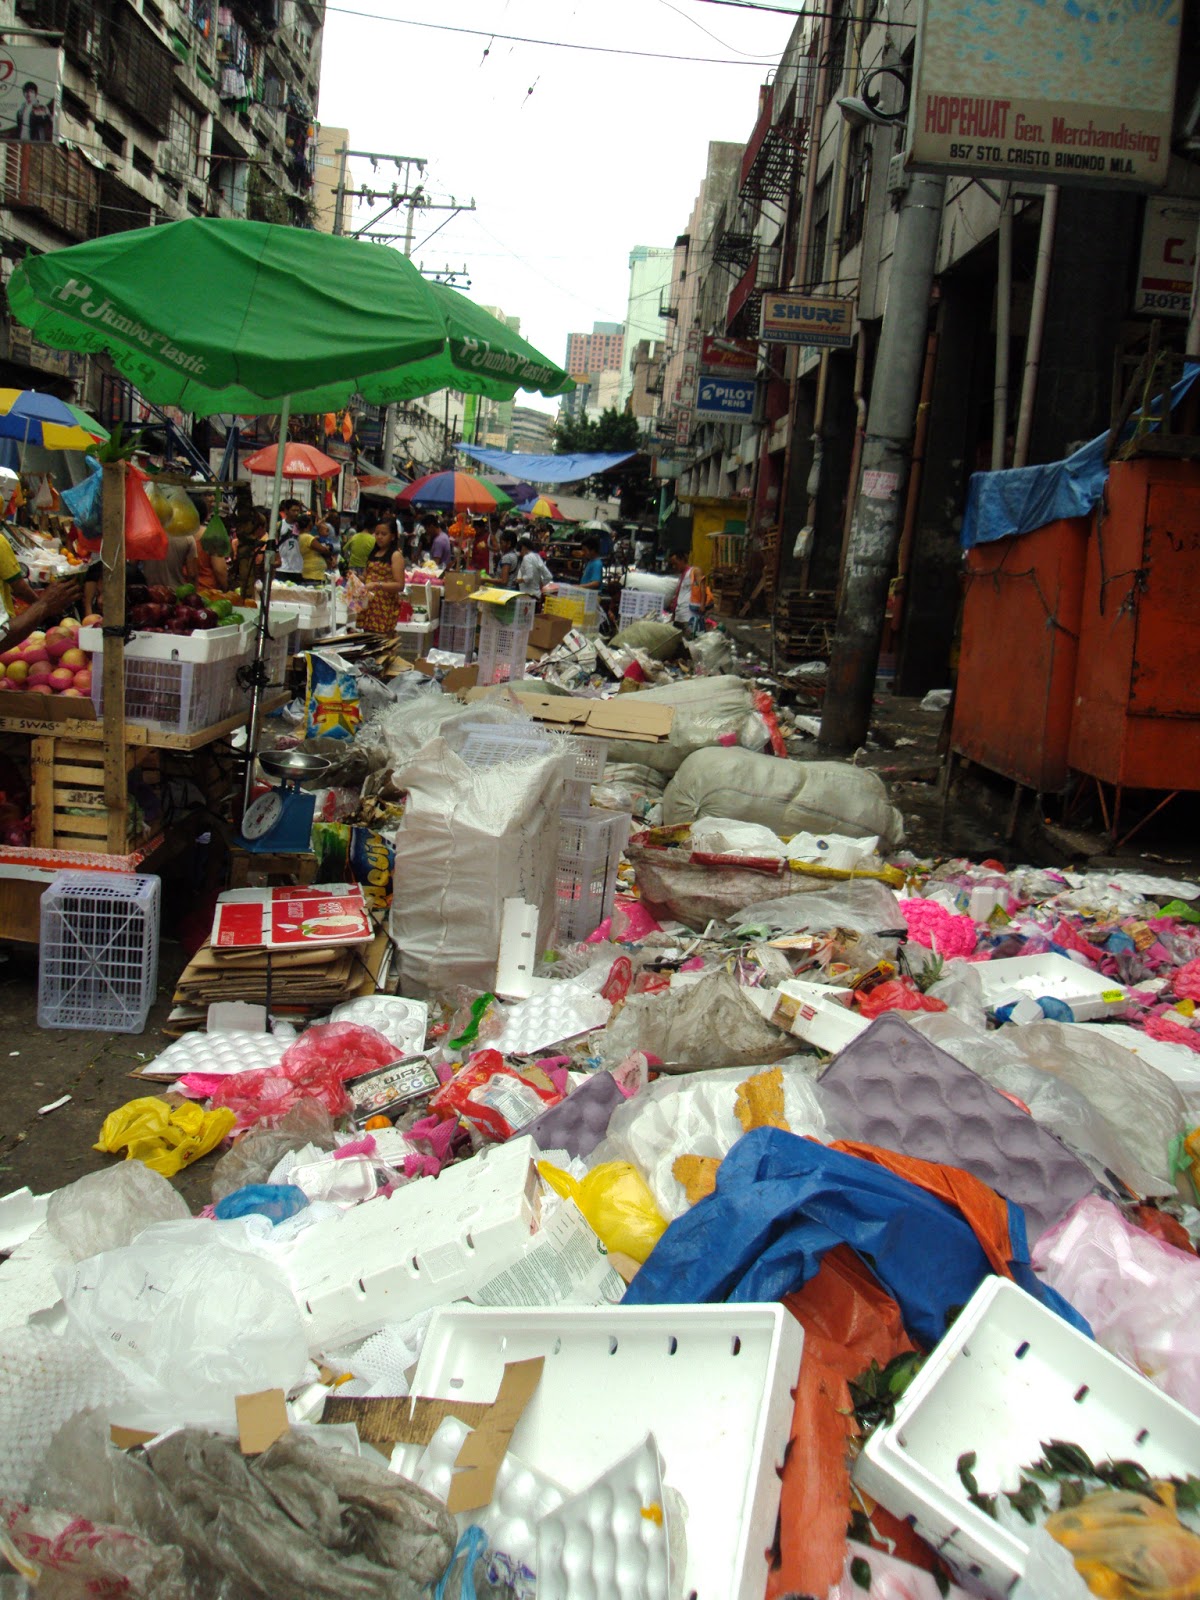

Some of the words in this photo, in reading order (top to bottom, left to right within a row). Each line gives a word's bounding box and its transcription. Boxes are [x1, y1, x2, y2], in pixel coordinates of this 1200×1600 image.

[924, 95, 1011, 139] HOPEHUAT
[1014, 113, 1045, 143] Gen.
[1051, 117, 1161, 162] Merchandising
[950, 143, 974, 158] 857
[976, 146, 1003, 163] STO.
[1007, 148, 1050, 166] CRISTO
[1055, 152, 1105, 171] BINONDO
[1110, 157, 1137, 174] MLA.
[773, 303, 846, 326] SHURE
[715, 387, 754, 401] PILOT
[721, 398, 746, 409] PENS
[288, 541, 295, 551] 5
